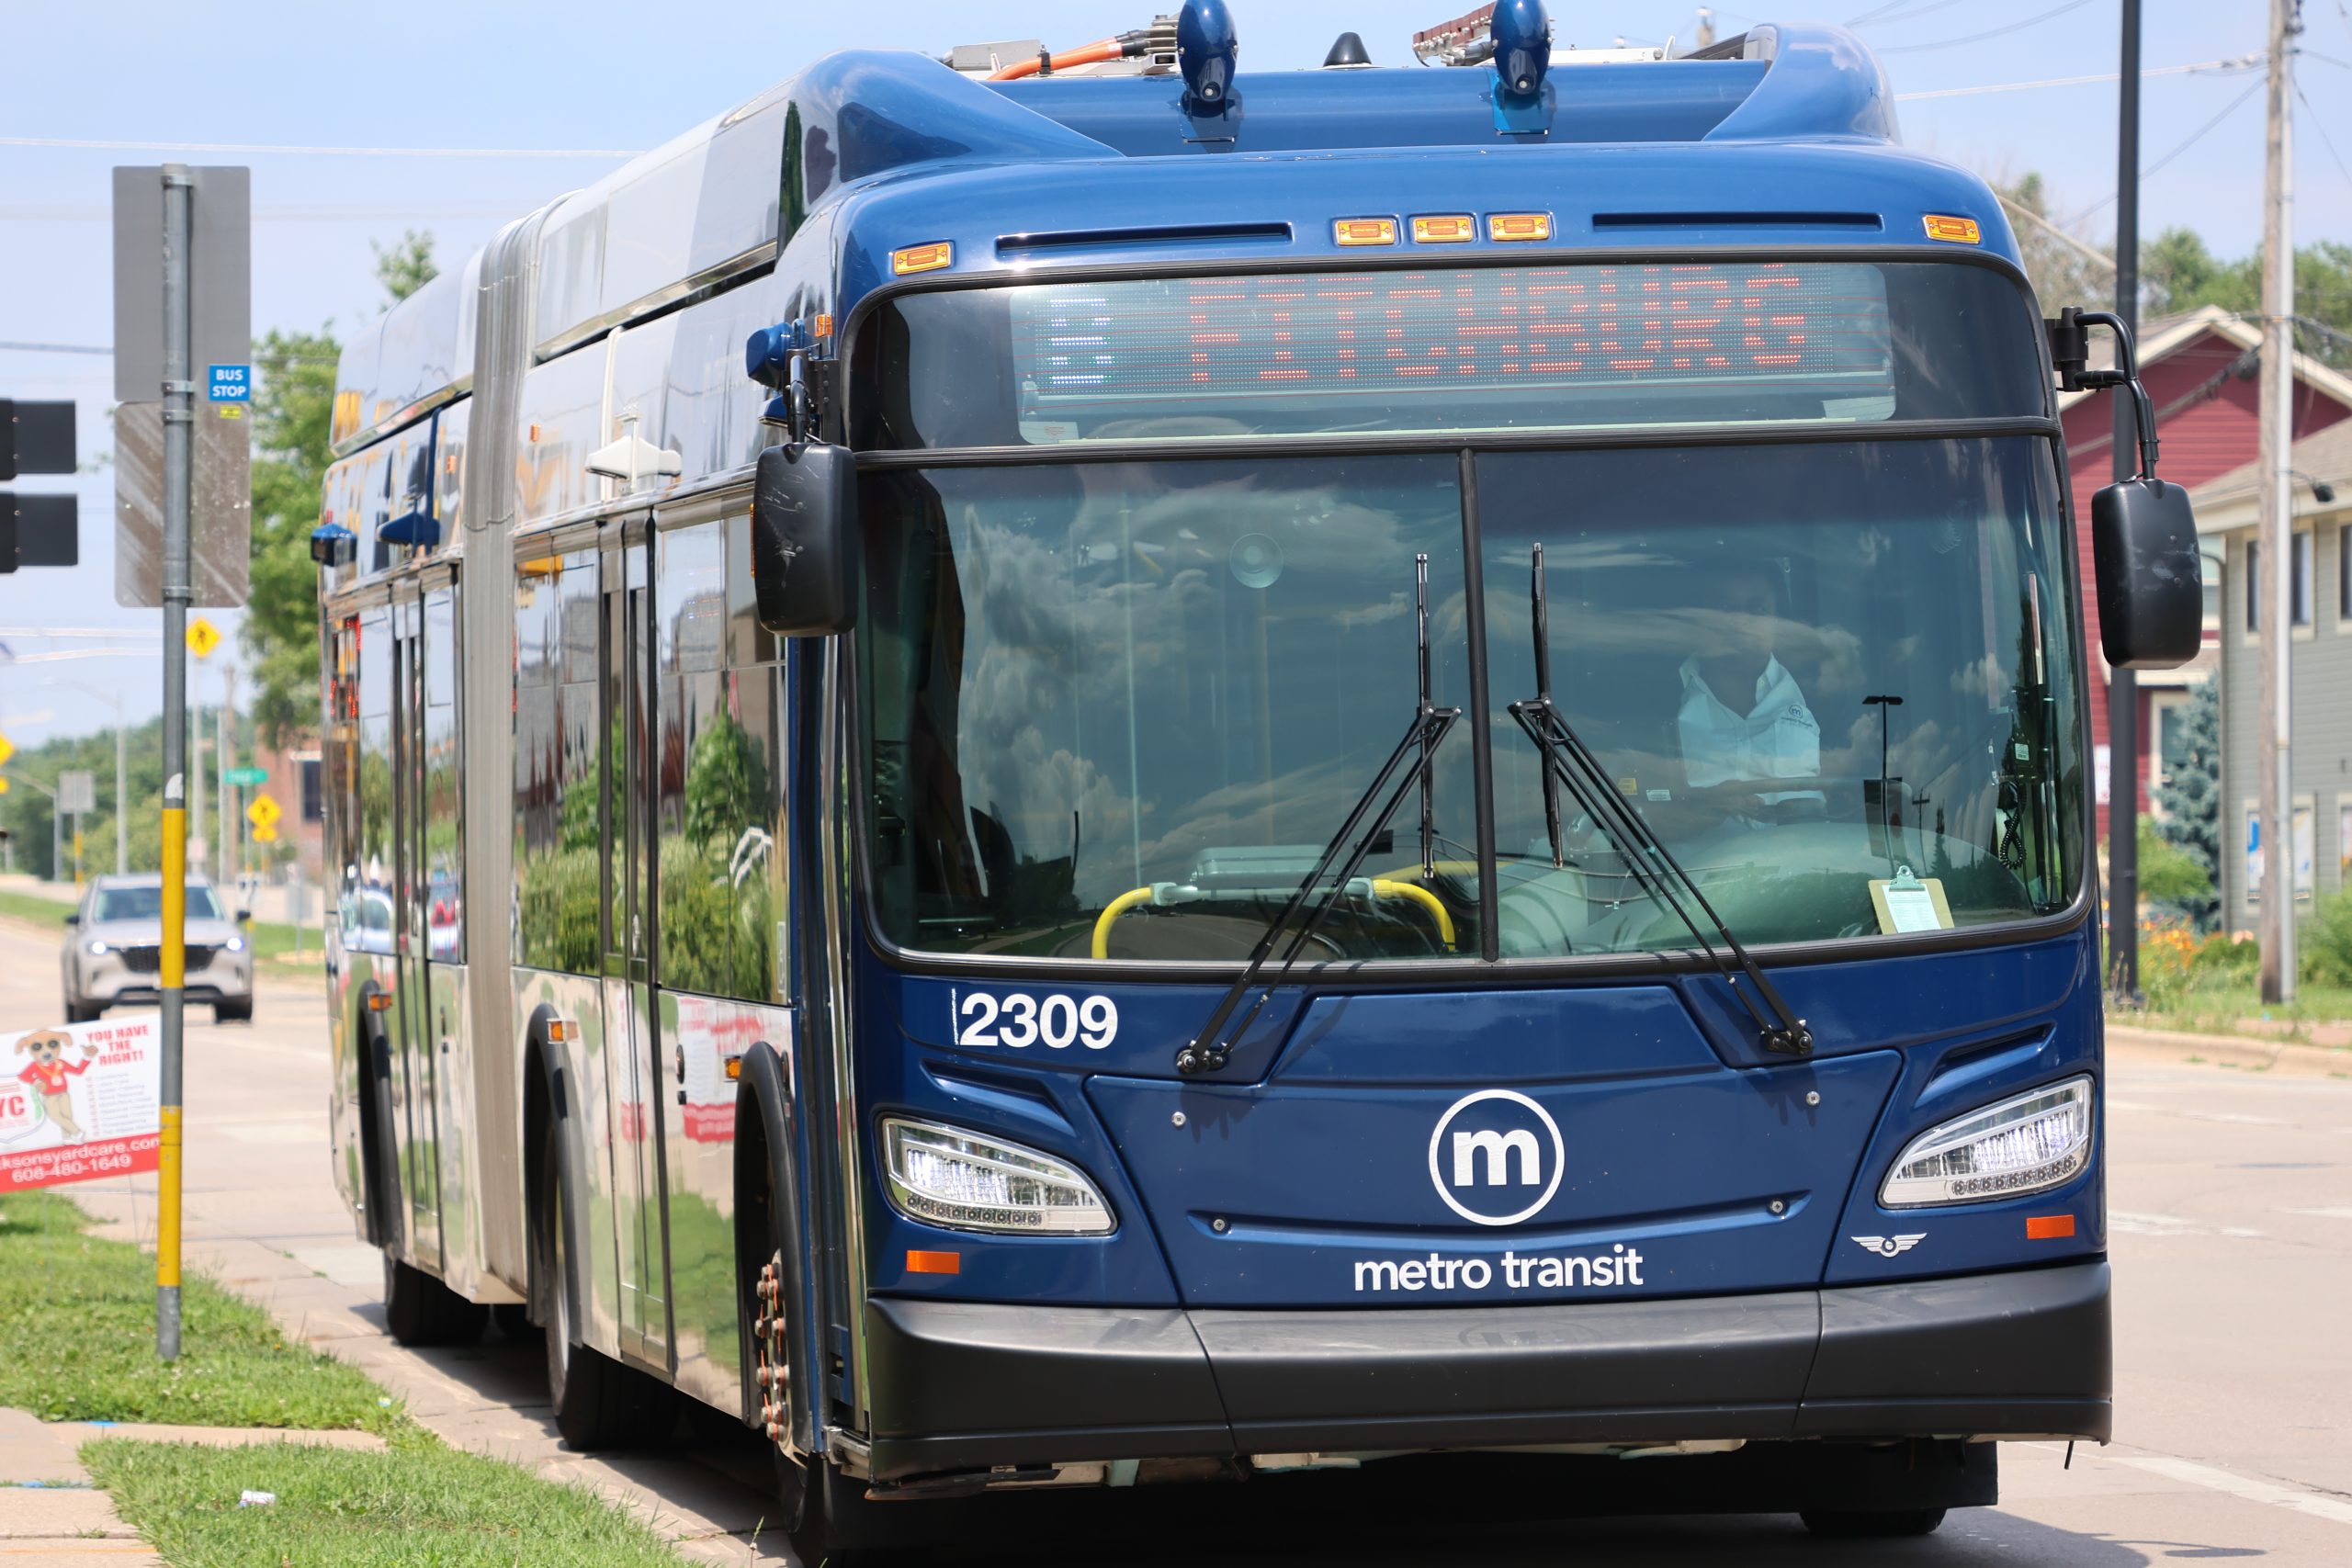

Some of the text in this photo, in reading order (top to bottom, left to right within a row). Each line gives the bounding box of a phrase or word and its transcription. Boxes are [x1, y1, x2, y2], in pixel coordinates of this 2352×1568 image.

[1190, 263, 1806, 382] FITCHBURG
[216, 369, 243, 380] BUS
[212, 386, 246, 397] STOP
[960, 992, 1118, 1049] 2309
[86, 1024, 149, 1042] YOU HAVE
[108, 1040, 131, 1052] THE
[99, 1050, 143, 1066] RIGHT!
[12, 1153, 131, 1183] 608-480-1649
[1354, 1244, 1644, 1291] metro transit
